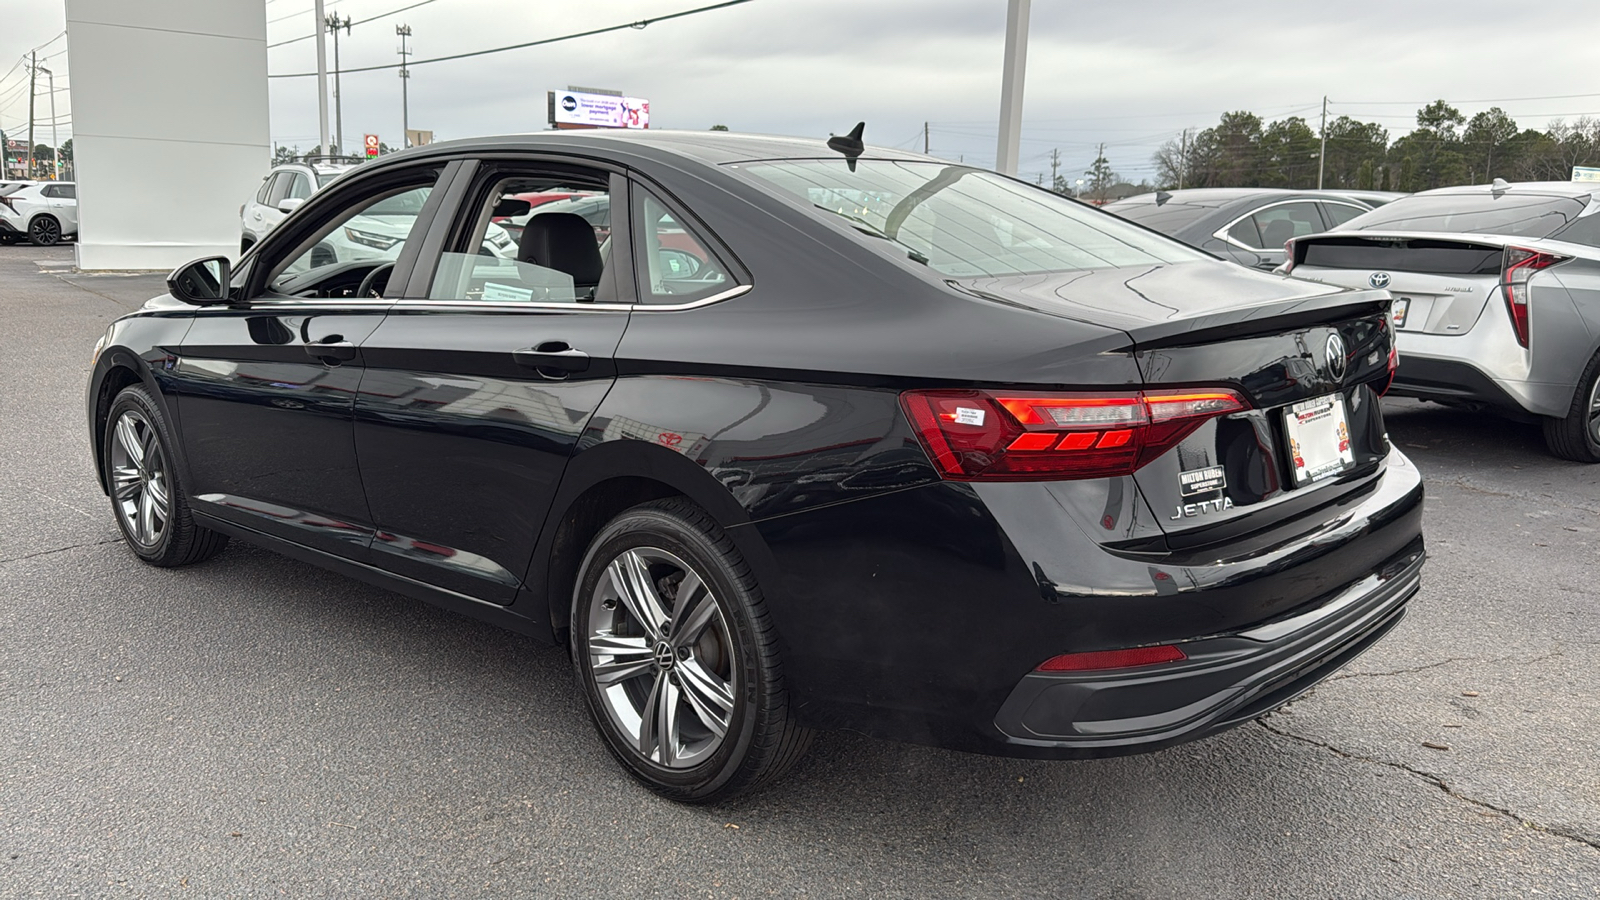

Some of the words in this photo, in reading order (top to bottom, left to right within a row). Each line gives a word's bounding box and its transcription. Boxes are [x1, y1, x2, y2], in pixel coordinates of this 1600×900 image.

[1313, 407, 1331, 416] RUBEN
[1181, 470, 1204, 485] MILTON
[1203, 467, 1223, 480] RUBEN
[1170, 496, 1234, 520] JETTA
